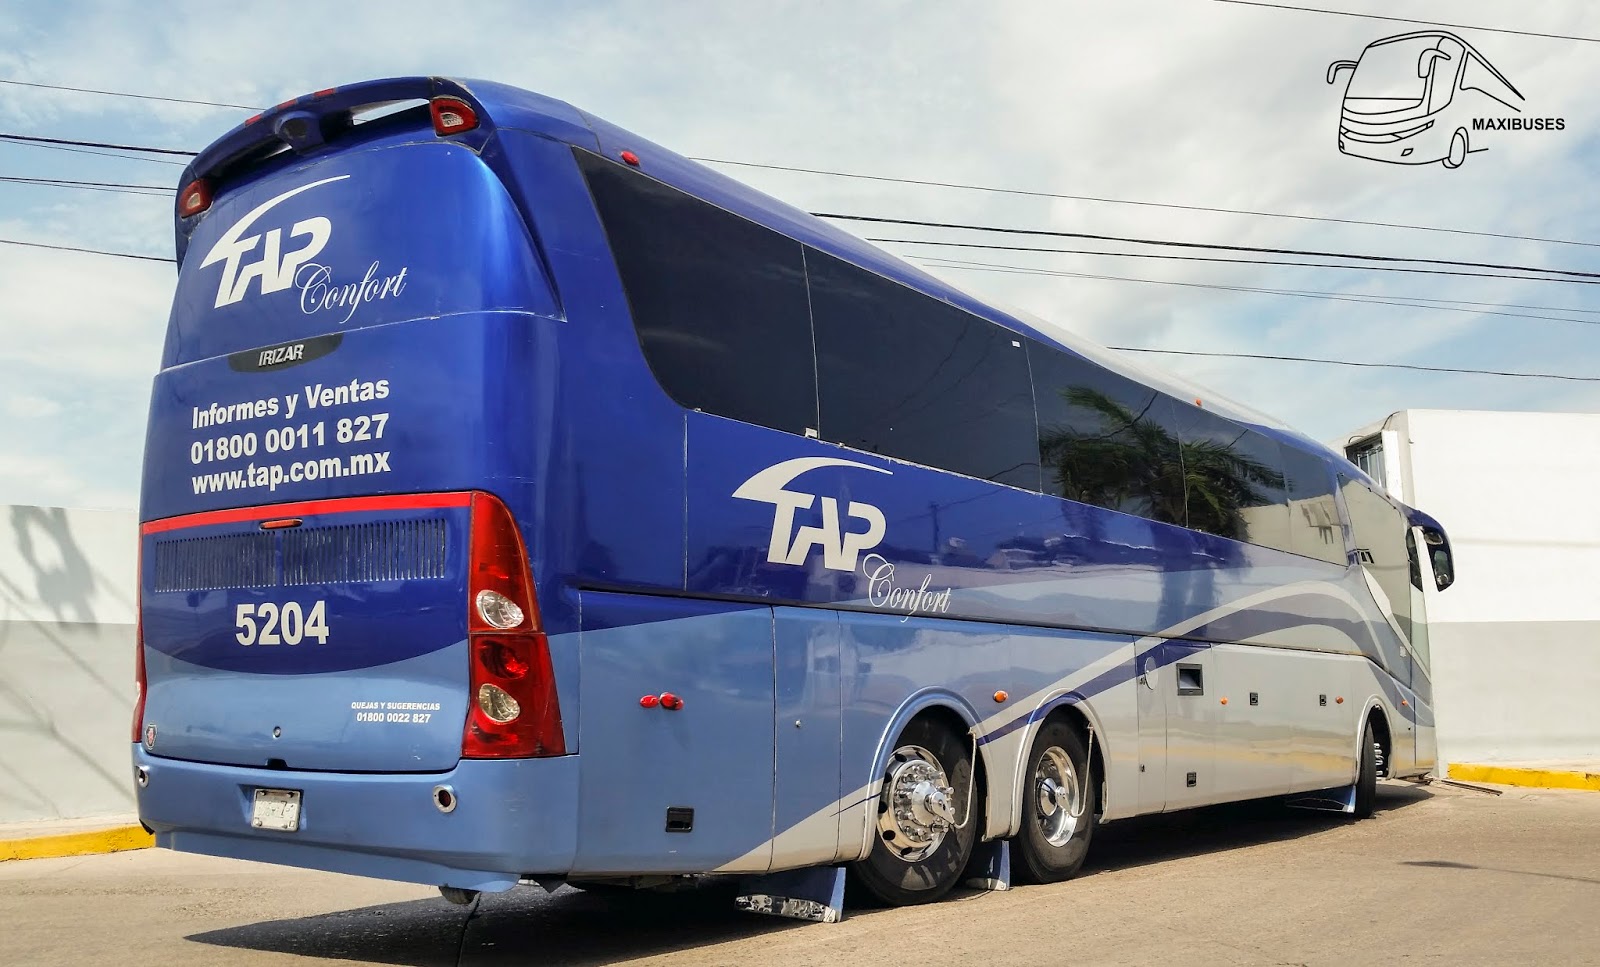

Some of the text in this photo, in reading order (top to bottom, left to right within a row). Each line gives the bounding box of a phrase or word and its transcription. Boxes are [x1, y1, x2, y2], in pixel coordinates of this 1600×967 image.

[200, 174, 351, 309] TAP
[295, 260, 408, 324] Confort
[258, 344, 305, 368] IRIZAR
[192, 378, 390, 430] Informes y Ventas
[190, 412, 390, 465] 01800 0011 827
[191, 451, 391, 495] www.tap.com.mx
[731, 456, 894, 572] TAP
[862, 553, 952, 623] Confort
[235, 600, 330, 646] 5204
[351, 701, 441, 711] QUEJAS Y SUGERENCIAS
[356, 712, 432, 724] 01800 0022 827
